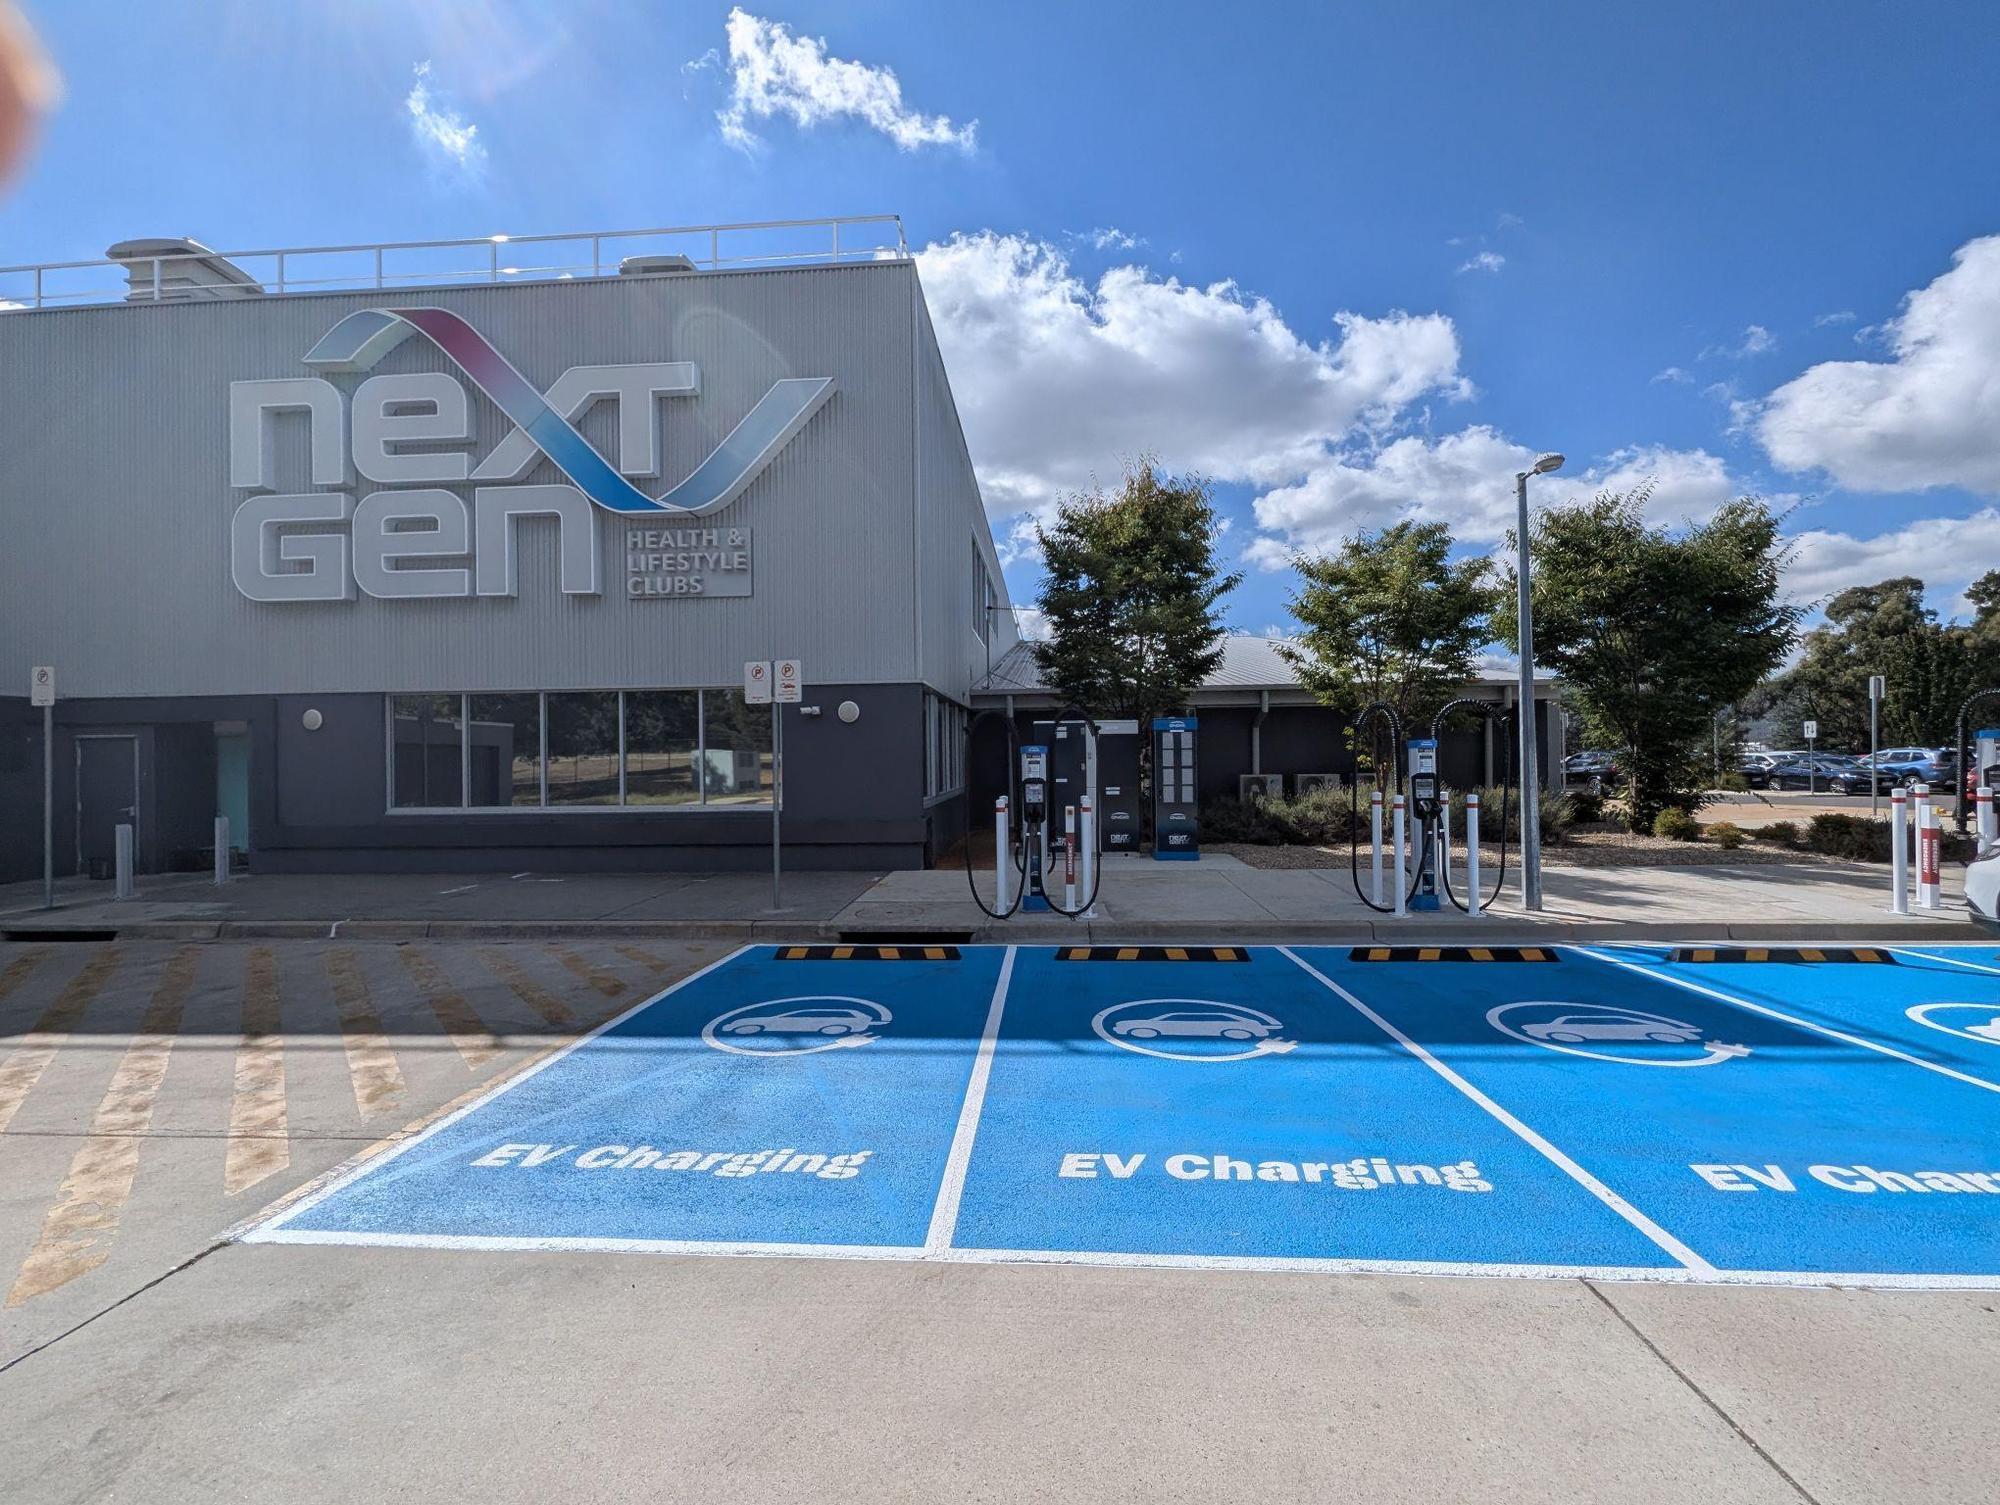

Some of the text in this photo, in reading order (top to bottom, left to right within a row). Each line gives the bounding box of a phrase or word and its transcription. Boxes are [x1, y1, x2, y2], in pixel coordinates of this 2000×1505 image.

[627, 528, 745, 548] HEALTH &
[627, 551, 748, 572] LIFESTYLE
[627, 575, 703, 595] CLUBS
[469, 1143, 874, 1180] EV Charging
[1058, 1153, 1495, 1193] EV Charging
[1688, 1164, 2000, 1194] EV Char
